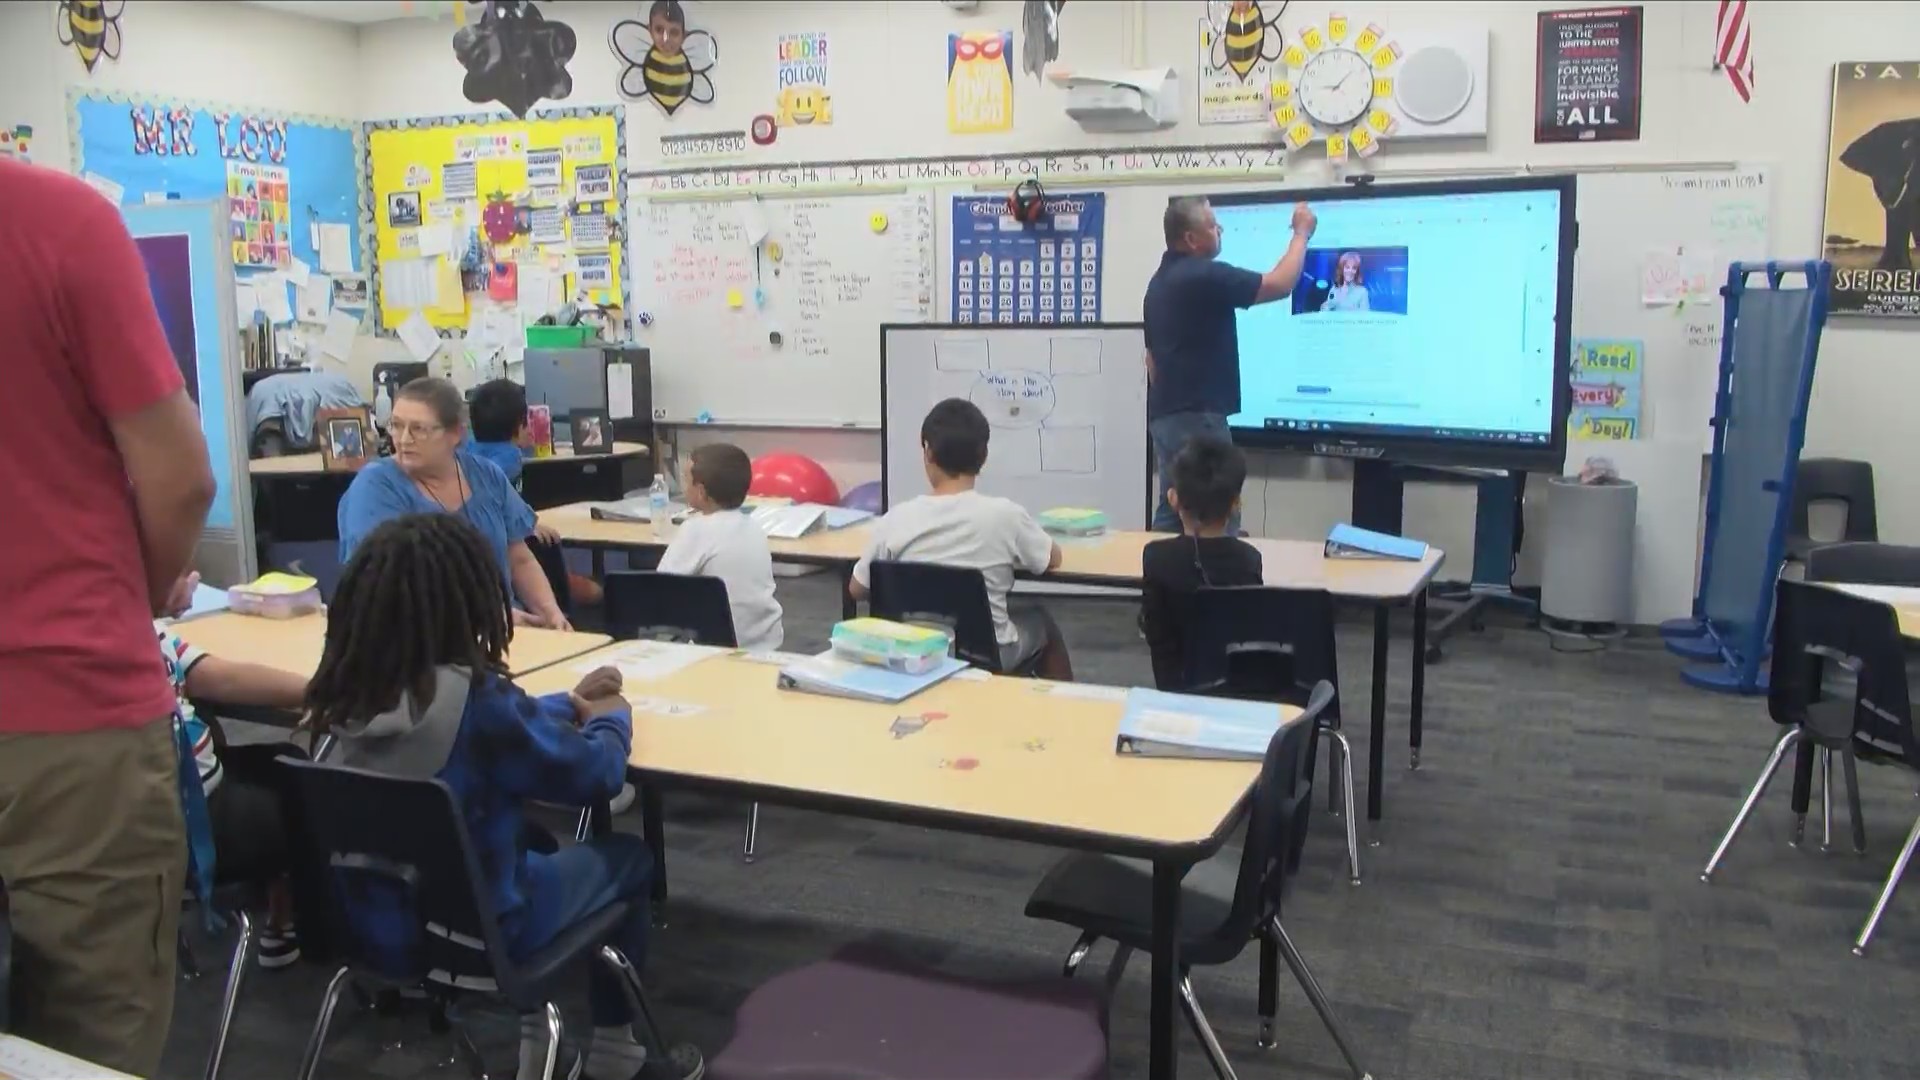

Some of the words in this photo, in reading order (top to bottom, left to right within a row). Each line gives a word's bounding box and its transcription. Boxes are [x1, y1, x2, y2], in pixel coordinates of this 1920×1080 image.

[1560, 31, 1573, 39] TO
[1576, 29, 1592, 38] THE
[1562, 39, 1590, 48] UNITED
[1592, 37, 1619, 46] STATES
[779, 39, 827, 60] LEADER
[1558, 65, 1578, 75] FOR
[1581, 64, 1619, 74] WHICH
[1853, 63, 1920, 79] SA
[780, 66, 827, 90] FOLLOW
[1558, 75, 1567, 84] IT
[1573, 73, 1619, 85] STANDS
[1567, 105, 1619, 125] ALL
[131, 105, 198, 156] MR
[214, 112, 287, 163] LOU
[652, 177, 666, 189] Aa
[671, 176, 686, 188] Bb
[692, 176, 707, 187] Cc
[714, 174, 730, 186] Dd
[779, 170, 797, 187] Gg
[803, 168, 819, 182] Hh
[849, 166, 864, 186] Jj
[872, 165, 887, 179] Kk
[898, 164, 910, 178] Ll
[917, 164, 939, 178] Mm
[944, 163, 961, 177] Nn
[968, 161, 987, 176] Oo
[995, 160, 1011, 180] Pp
[1018, 159, 1039, 179] Qq
[1045, 158, 1062, 173] Rr
[1073, 157, 1089, 171] Ss
[1101, 155, 1113, 170] Tt
[1124, 154, 1142, 169] Uu
[1151, 153, 1169, 169] Vv
[1176, 152, 1200, 168] Ww
[1207, 151, 1226, 167] Xx
[1235, 151, 1253, 173] Yy
[1265, 151, 1283, 167] Zz
[970, 201, 1014, 216] Calend
[1045, 200, 1085, 214] eather
[1065, 246, 1070, 254] 2
[1084, 264, 1093, 272] 10
[962, 281, 969, 290] 11
[982, 281, 990, 290] 12
[1002, 281, 1011, 290] 13
[1022, 281, 1030, 290] 14
[1043, 281, 1051, 290] 15
[1063, 281, 1072, 290] 16
[1084, 281, 1092, 290] 17
[1835, 268, 1920, 292] SERE
[961, 298, 970, 306] 18
[982, 298, 990, 306] 19
[1001, 298, 1011, 306] 20
[1022, 298, 1031, 306] 21
[1041, 298, 1052, 306] 22
[1062, 298, 1073, 306] 23
[1083, 298, 1094, 306] 24
[1867, 294, 1920, 303] GUIDED
[1587, 349, 1632, 370] Read
[986, 375, 1006, 385] What
[1024, 375, 1037, 386] the
[997, 387, 1015, 400] story
[1592, 420, 1629, 440] Day!
